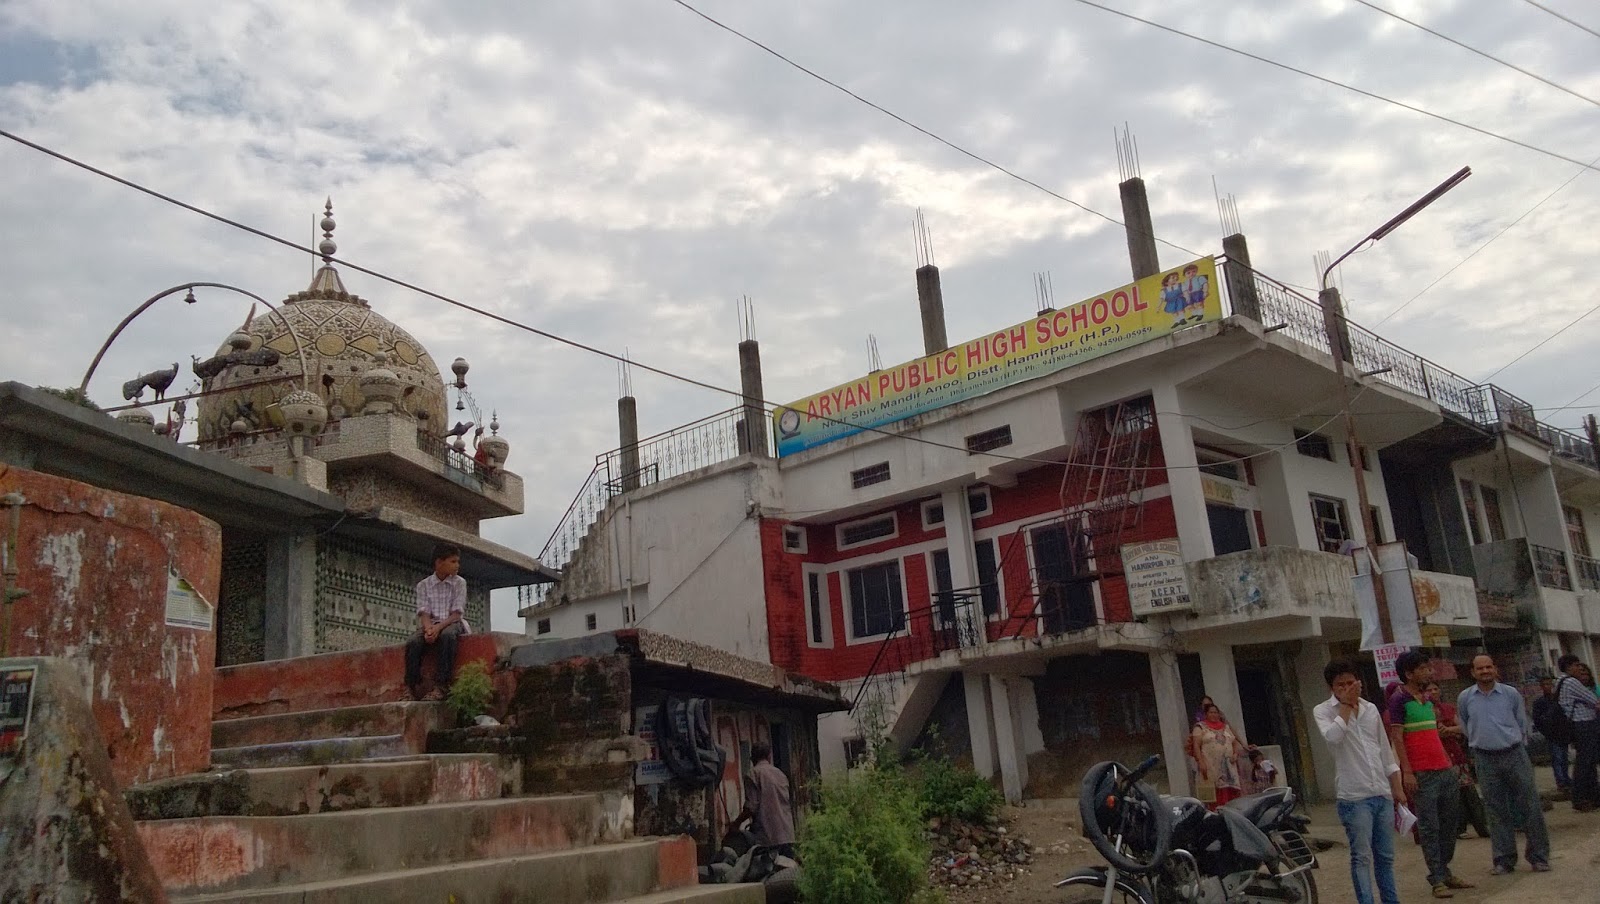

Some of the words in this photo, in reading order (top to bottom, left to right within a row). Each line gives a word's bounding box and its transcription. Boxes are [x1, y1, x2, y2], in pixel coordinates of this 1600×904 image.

[807, 380, 871, 422] ARYAN
[878, 351, 958, 398] PUBLIC
[966, 325, 1026, 368] HIGH
[1036, 286, 1148, 344] SCHOOL
[822, 416, 846, 430] Near
[851, 407, 877, 420] Shiv
[880, 390, 922, 410] Mandir
[925, 379, 963, 396] Anoo,
[967, 364, 1003, 381] Distt.
[1007, 340, 1075, 367] Hamirpur
[1080, 323, 1121, 345] (H.P.)
